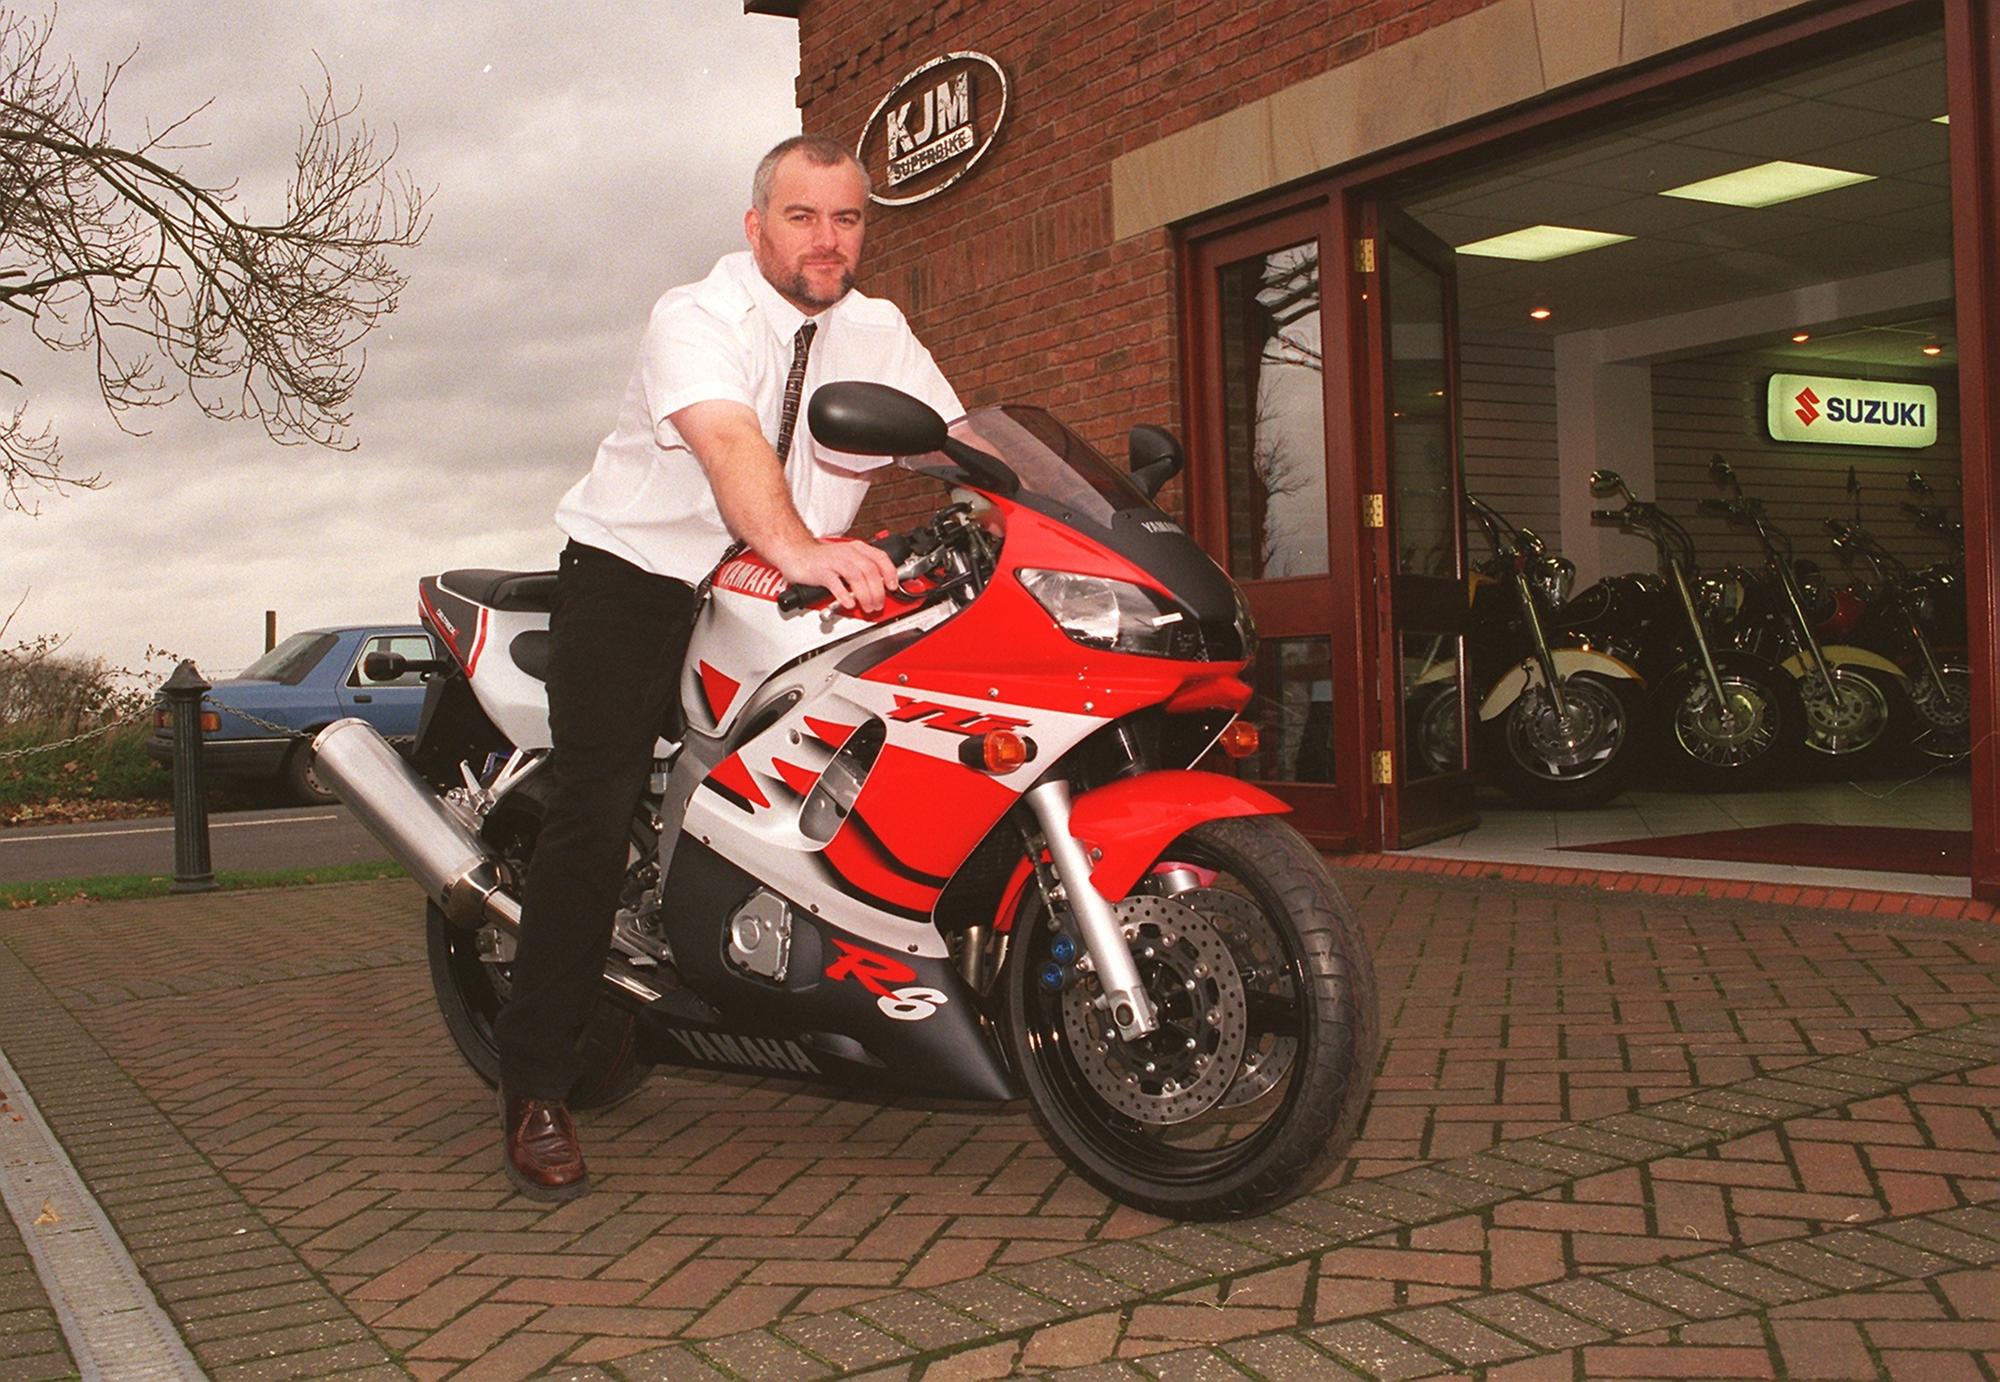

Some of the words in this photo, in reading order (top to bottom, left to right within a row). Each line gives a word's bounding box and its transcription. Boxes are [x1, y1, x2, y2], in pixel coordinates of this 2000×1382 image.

[886, 71, 969, 161] KJM
[891, 130, 970, 180] SUPERBIKE
[1826, 397, 1925, 427] SUZUKI
[1140, 521, 1184, 535] YAMA
[825, 938, 949, 1020] R6
[667, 1028, 822, 1074] YAMAHA
